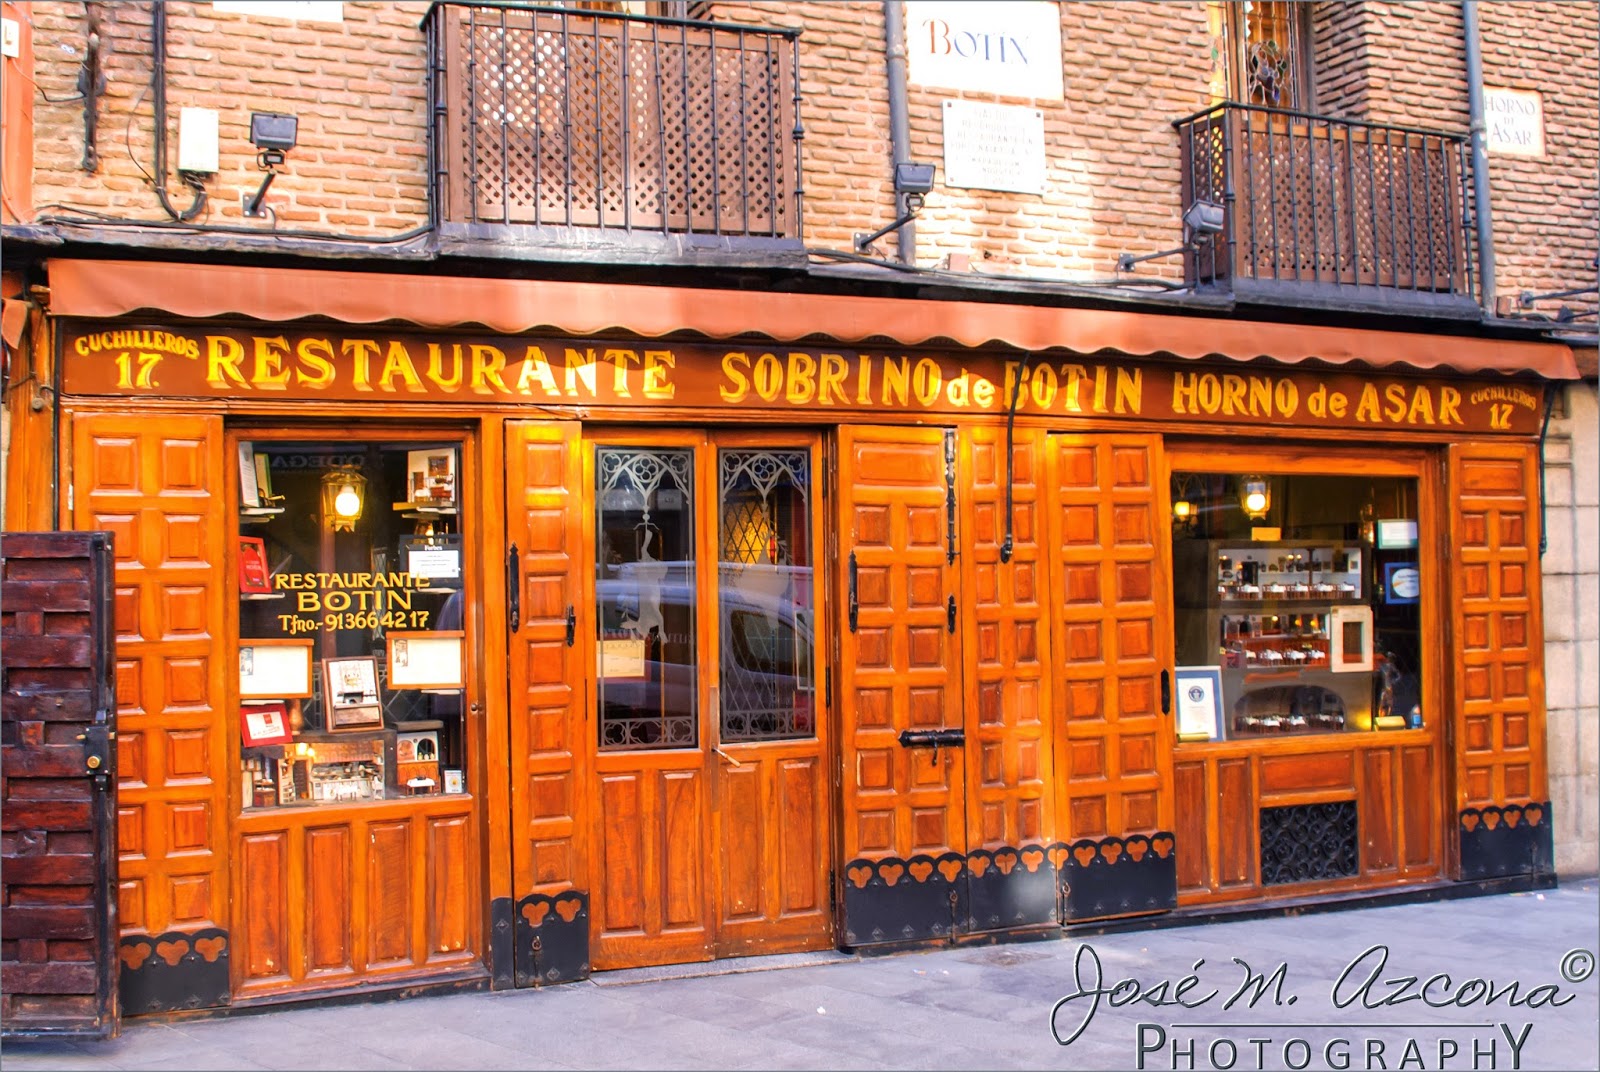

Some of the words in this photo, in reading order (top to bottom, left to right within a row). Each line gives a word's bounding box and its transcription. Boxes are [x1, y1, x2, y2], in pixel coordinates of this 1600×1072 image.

[1484, 95, 1536, 116] HORNO
[1491, 122, 1533, 145] ASAR
[75, 330, 200, 360] CUCHILLEROS
[205, 334, 676, 400] RESTAURANTE
[719, 352, 942, 406] SOBRINO
[946, 367, 996, 408] de
[1003, 361, 1143, 415] BOTIN
[1172, 371, 1299, 418] HORNO
[1307, 382, 1348, 418] de
[1355, 382, 1464, 425] ASAR
[1471, 386, 1537, 411] CUCHILLEROS
[275, 572, 430, 589] RESTAURANTE
[297, 590, 412, 612] BOTIN
